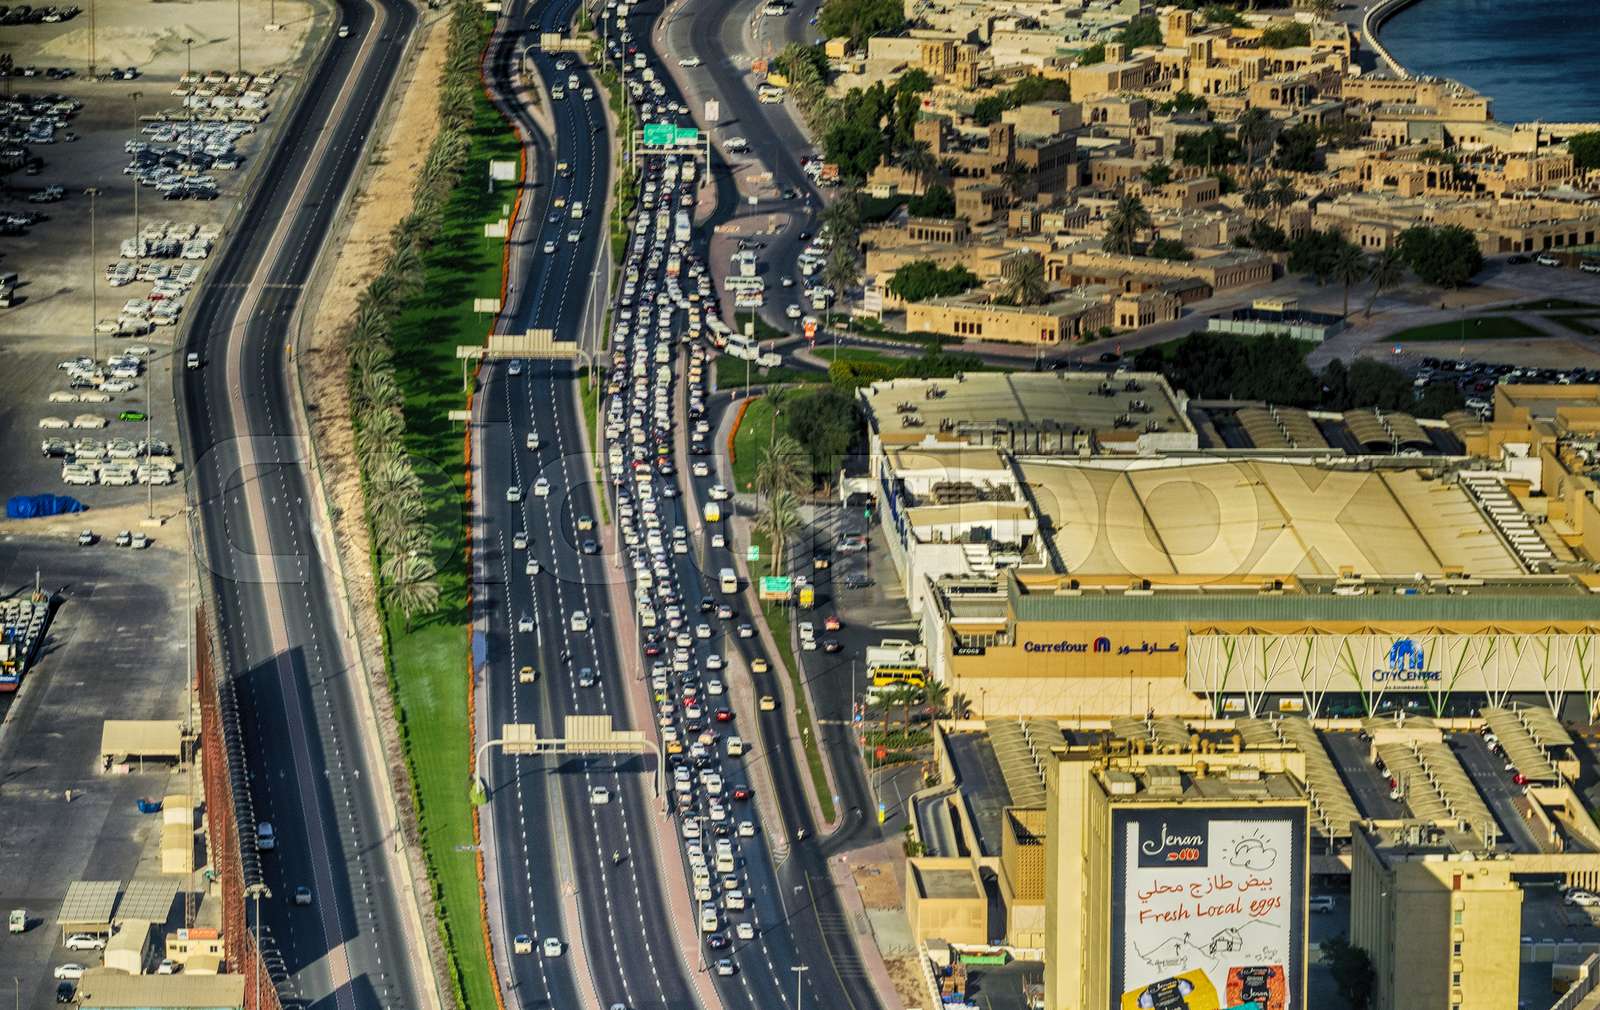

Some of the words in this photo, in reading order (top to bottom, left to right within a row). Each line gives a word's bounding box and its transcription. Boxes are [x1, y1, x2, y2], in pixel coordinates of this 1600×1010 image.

[1024, 641, 1088, 653] Carrefour
[1137, 879, 1184, 904] محلي
[1189, 874, 1233, 898] طازج
[1237, 874, 1273, 892] بيض
[1139, 901, 1190, 924] Fresh
[1197, 897, 1243, 918] Local
[1249, 896, 1281, 918] eggs
